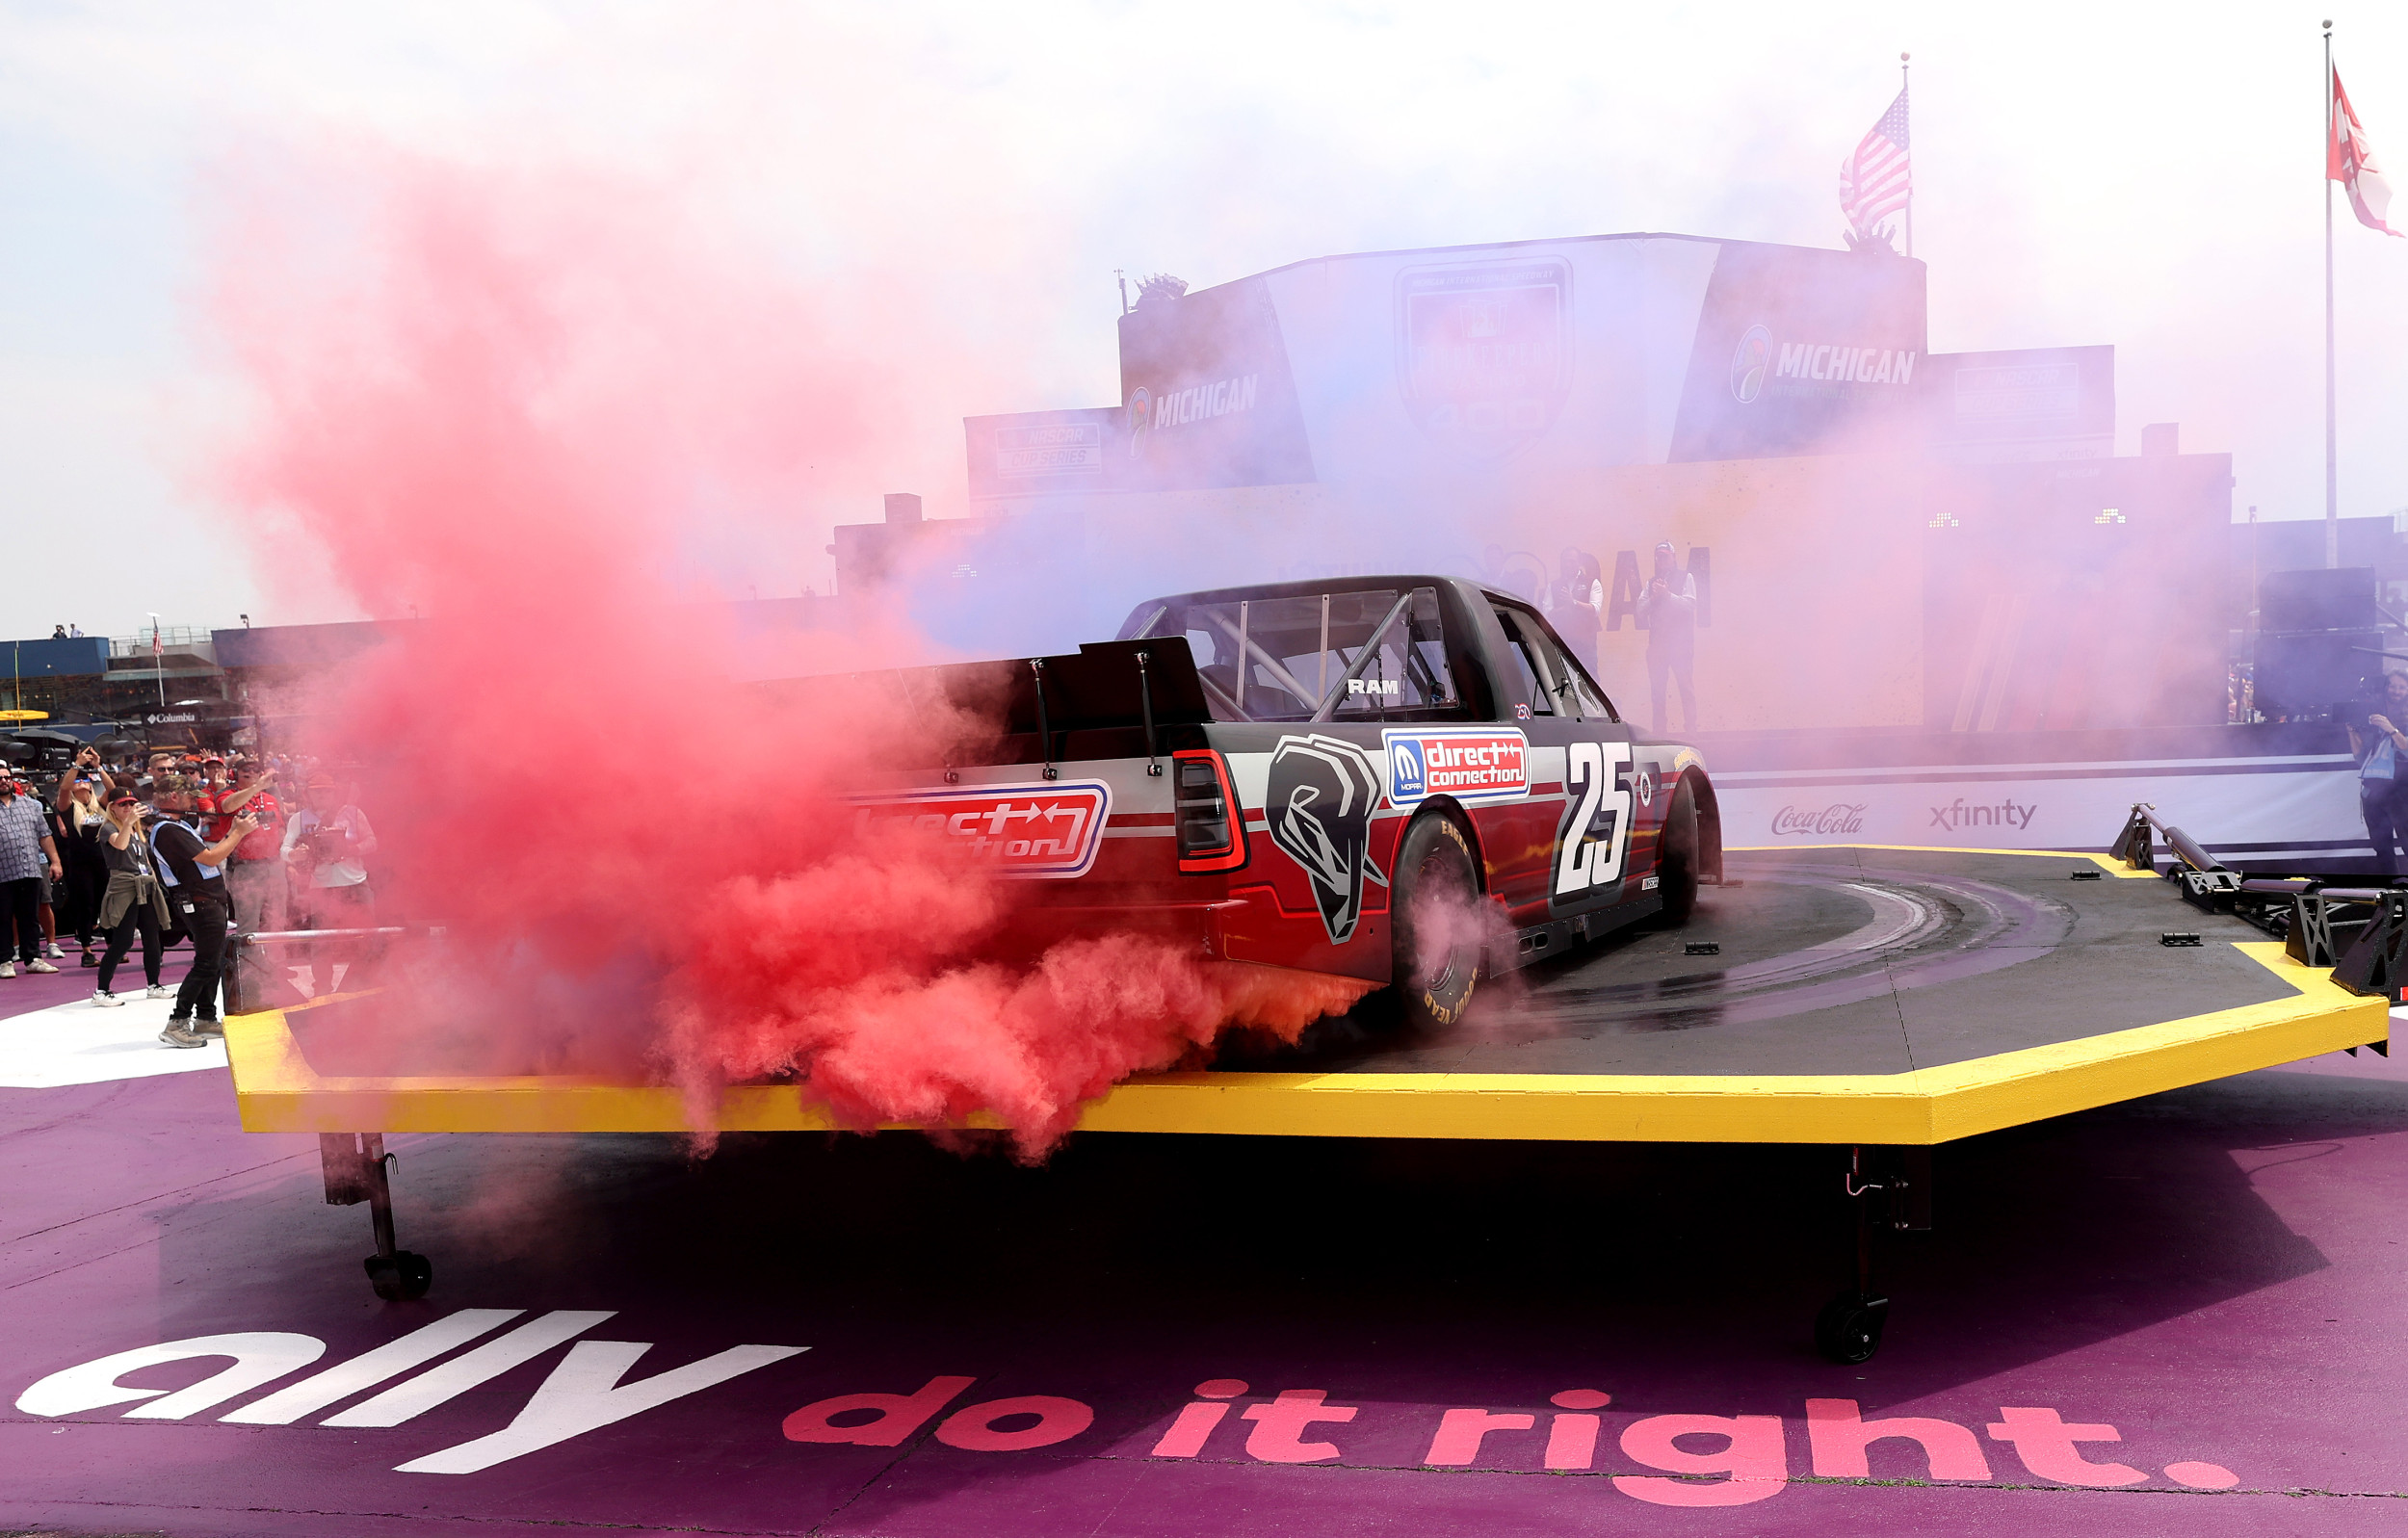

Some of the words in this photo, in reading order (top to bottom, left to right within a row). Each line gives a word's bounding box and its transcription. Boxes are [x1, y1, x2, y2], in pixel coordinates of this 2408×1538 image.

[1775, 342, 1916, 385] MICHIGAN
[1996, 369, 2060, 387] NASCAR
[1155, 373, 1258, 430] MICHIGAN
[1426, 398, 1546, 432] 400
[1029, 428, 1085, 445] NASCAR
[1011, 452, 1038, 467] CUP
[1040, 449, 1086, 465] SERIES
[1348, 678, 1399, 694] RAM
[156, 713, 195, 723] Columbia
[1426, 741, 1508, 768] direct
[1428, 765, 1525, 787] connection
[1556, 743, 1632, 896] 25
[1771, 802, 1869, 836] Coca-Cola
[1929, 797, 2038, 832] xfinity
[14, 1308, 812, 1475] ally
[782, 1376, 1094, 1452] do
[1149, 1378, 1359, 1465] it
[1423, 1388, 2241, 1509] right.
